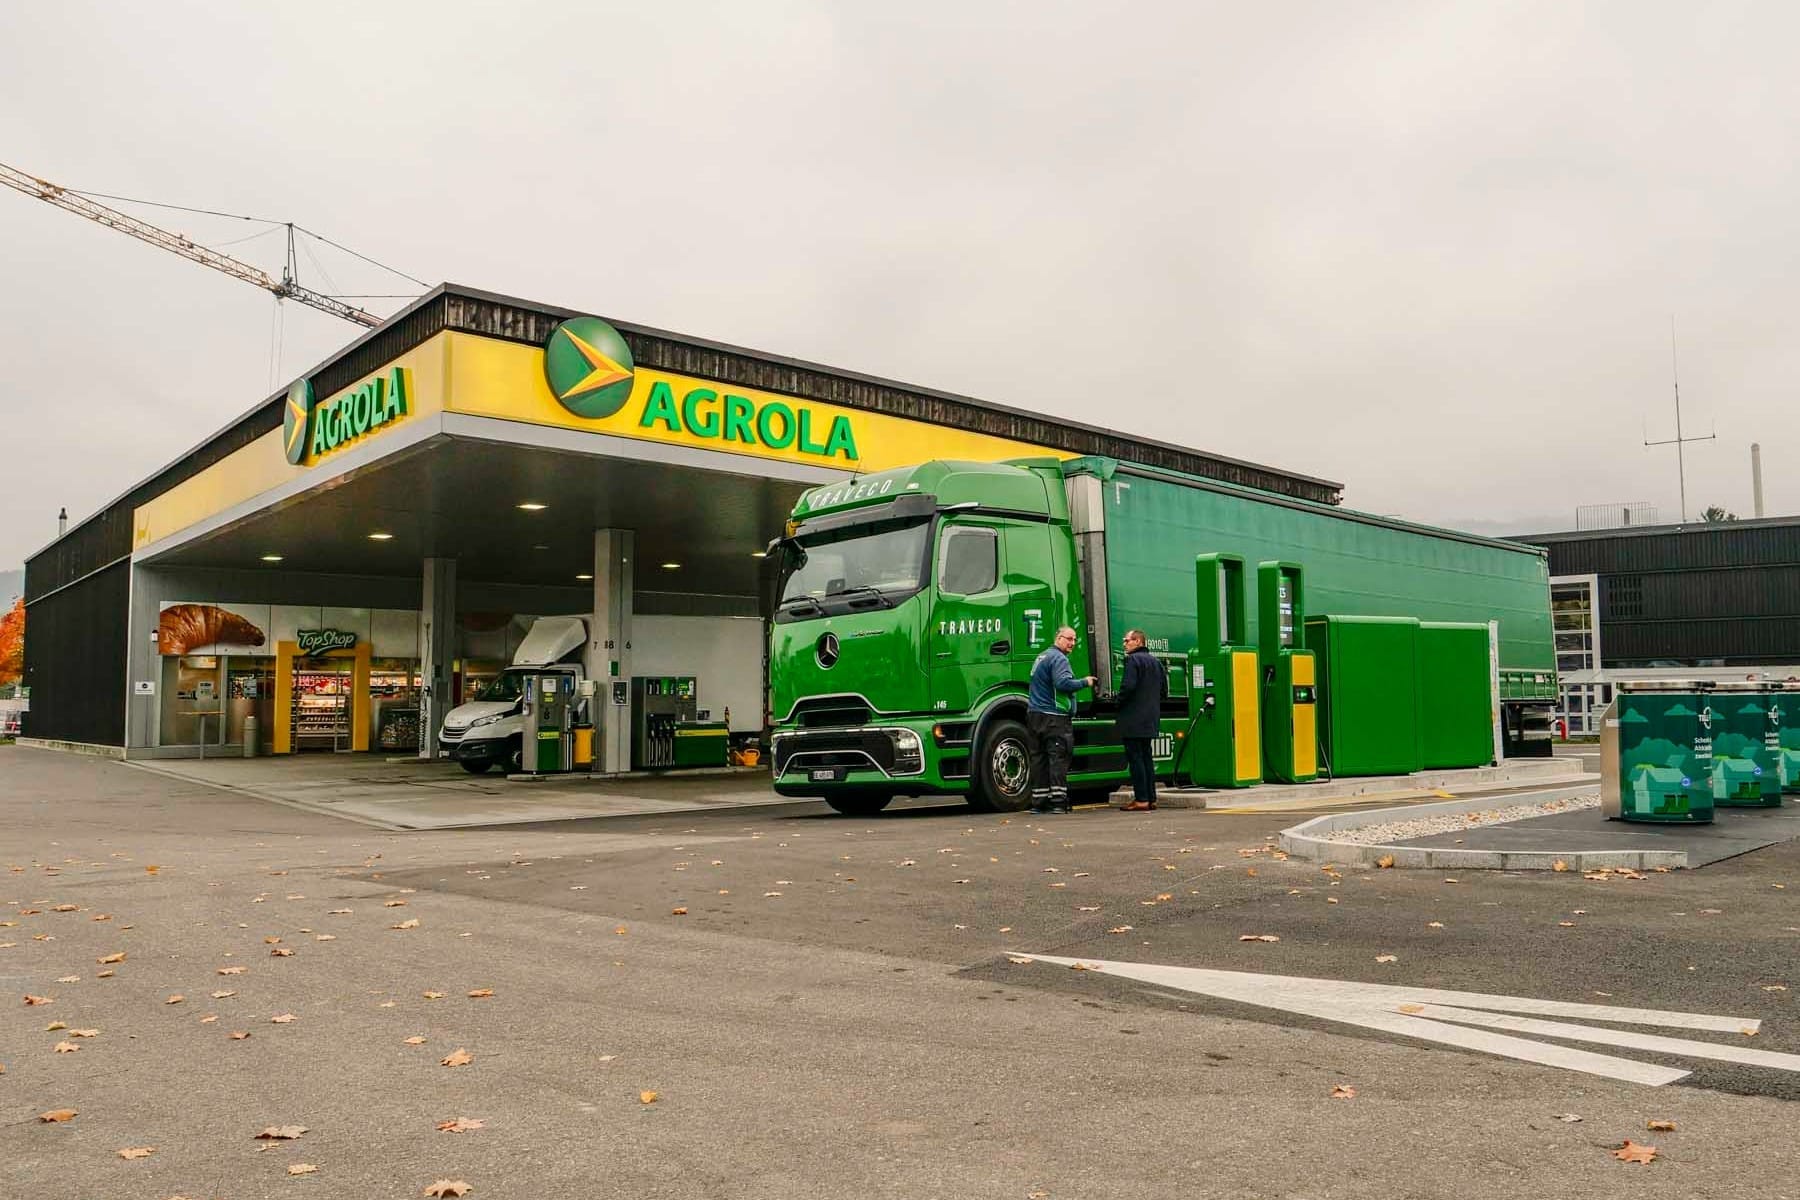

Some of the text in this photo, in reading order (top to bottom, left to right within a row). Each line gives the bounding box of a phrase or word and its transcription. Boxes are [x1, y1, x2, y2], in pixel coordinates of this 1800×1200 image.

[312, 367, 407, 455] AGROLA
[639, 381, 858, 460] AGROLA
[811, 480, 892, 509] TRAVECO
[939, 619, 1001, 634] TRAVECO
[625, 640, 631, 649] 6
[1145, 639, 1162, 650] 9010
